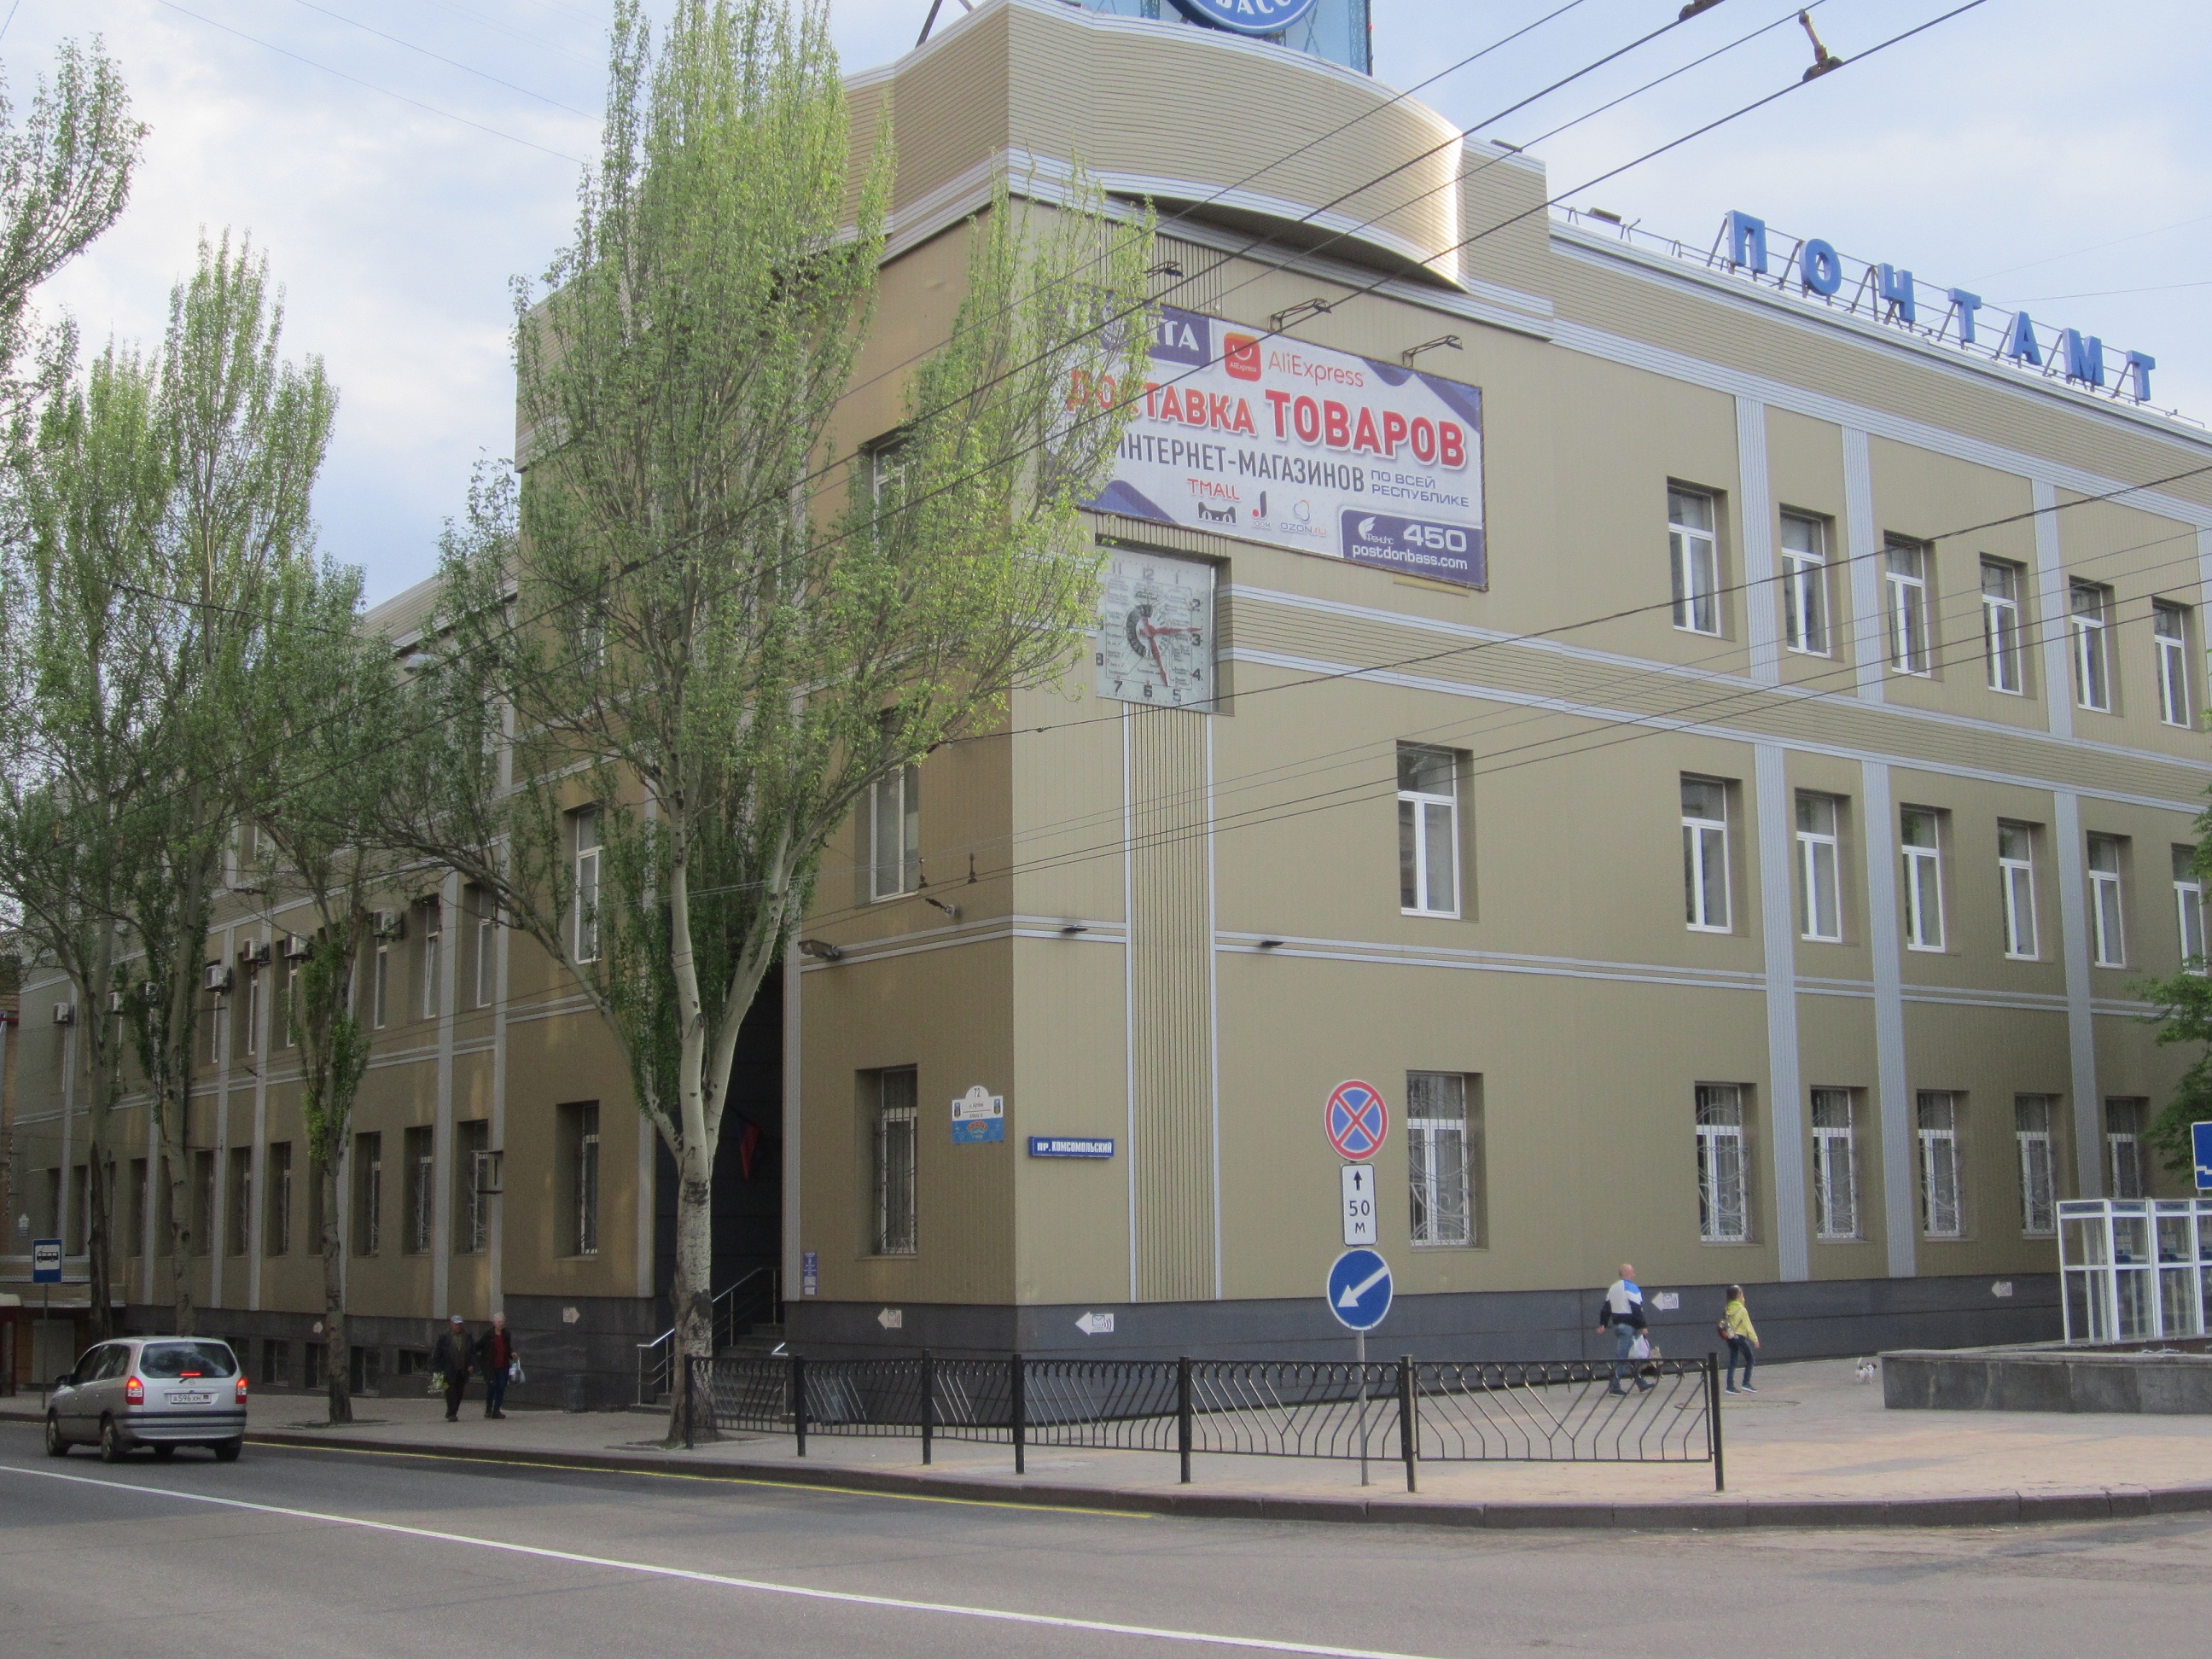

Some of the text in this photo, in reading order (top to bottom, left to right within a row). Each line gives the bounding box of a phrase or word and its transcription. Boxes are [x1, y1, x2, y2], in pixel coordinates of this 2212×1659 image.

[1726, 210, 2156, 402] ПОЧТАМТ
[1230, 362, 1256, 373] AliExpress
[1268, 351, 1364, 387] AliExpress
[1265, 389, 1464, 467] ТОВАРОВ
[1371, 470, 1435, 489] ПО ВСЕЙ
[1187, 478, 1240, 501] TMALL
[1371, 484, 1470, 507] РЕСПУБЛИКЕ
[1252, 520, 1271, 528] JOOM
[1403, 524, 1468, 552] 450
[1352, 544, 1468, 570] postdonbass.com
[1191, 633, 1202, 646] 3
[1192, 668, 1202, 681] 4
[1114, 680, 1123, 693] 7
[1144, 684, 1153, 698] 6
[1173, 688, 1182, 702] 5
[974, 1087, 981, 1097] 72
[1349, 1200, 1370, 1216] 50
[1355, 1222, 1365, 1234] М
